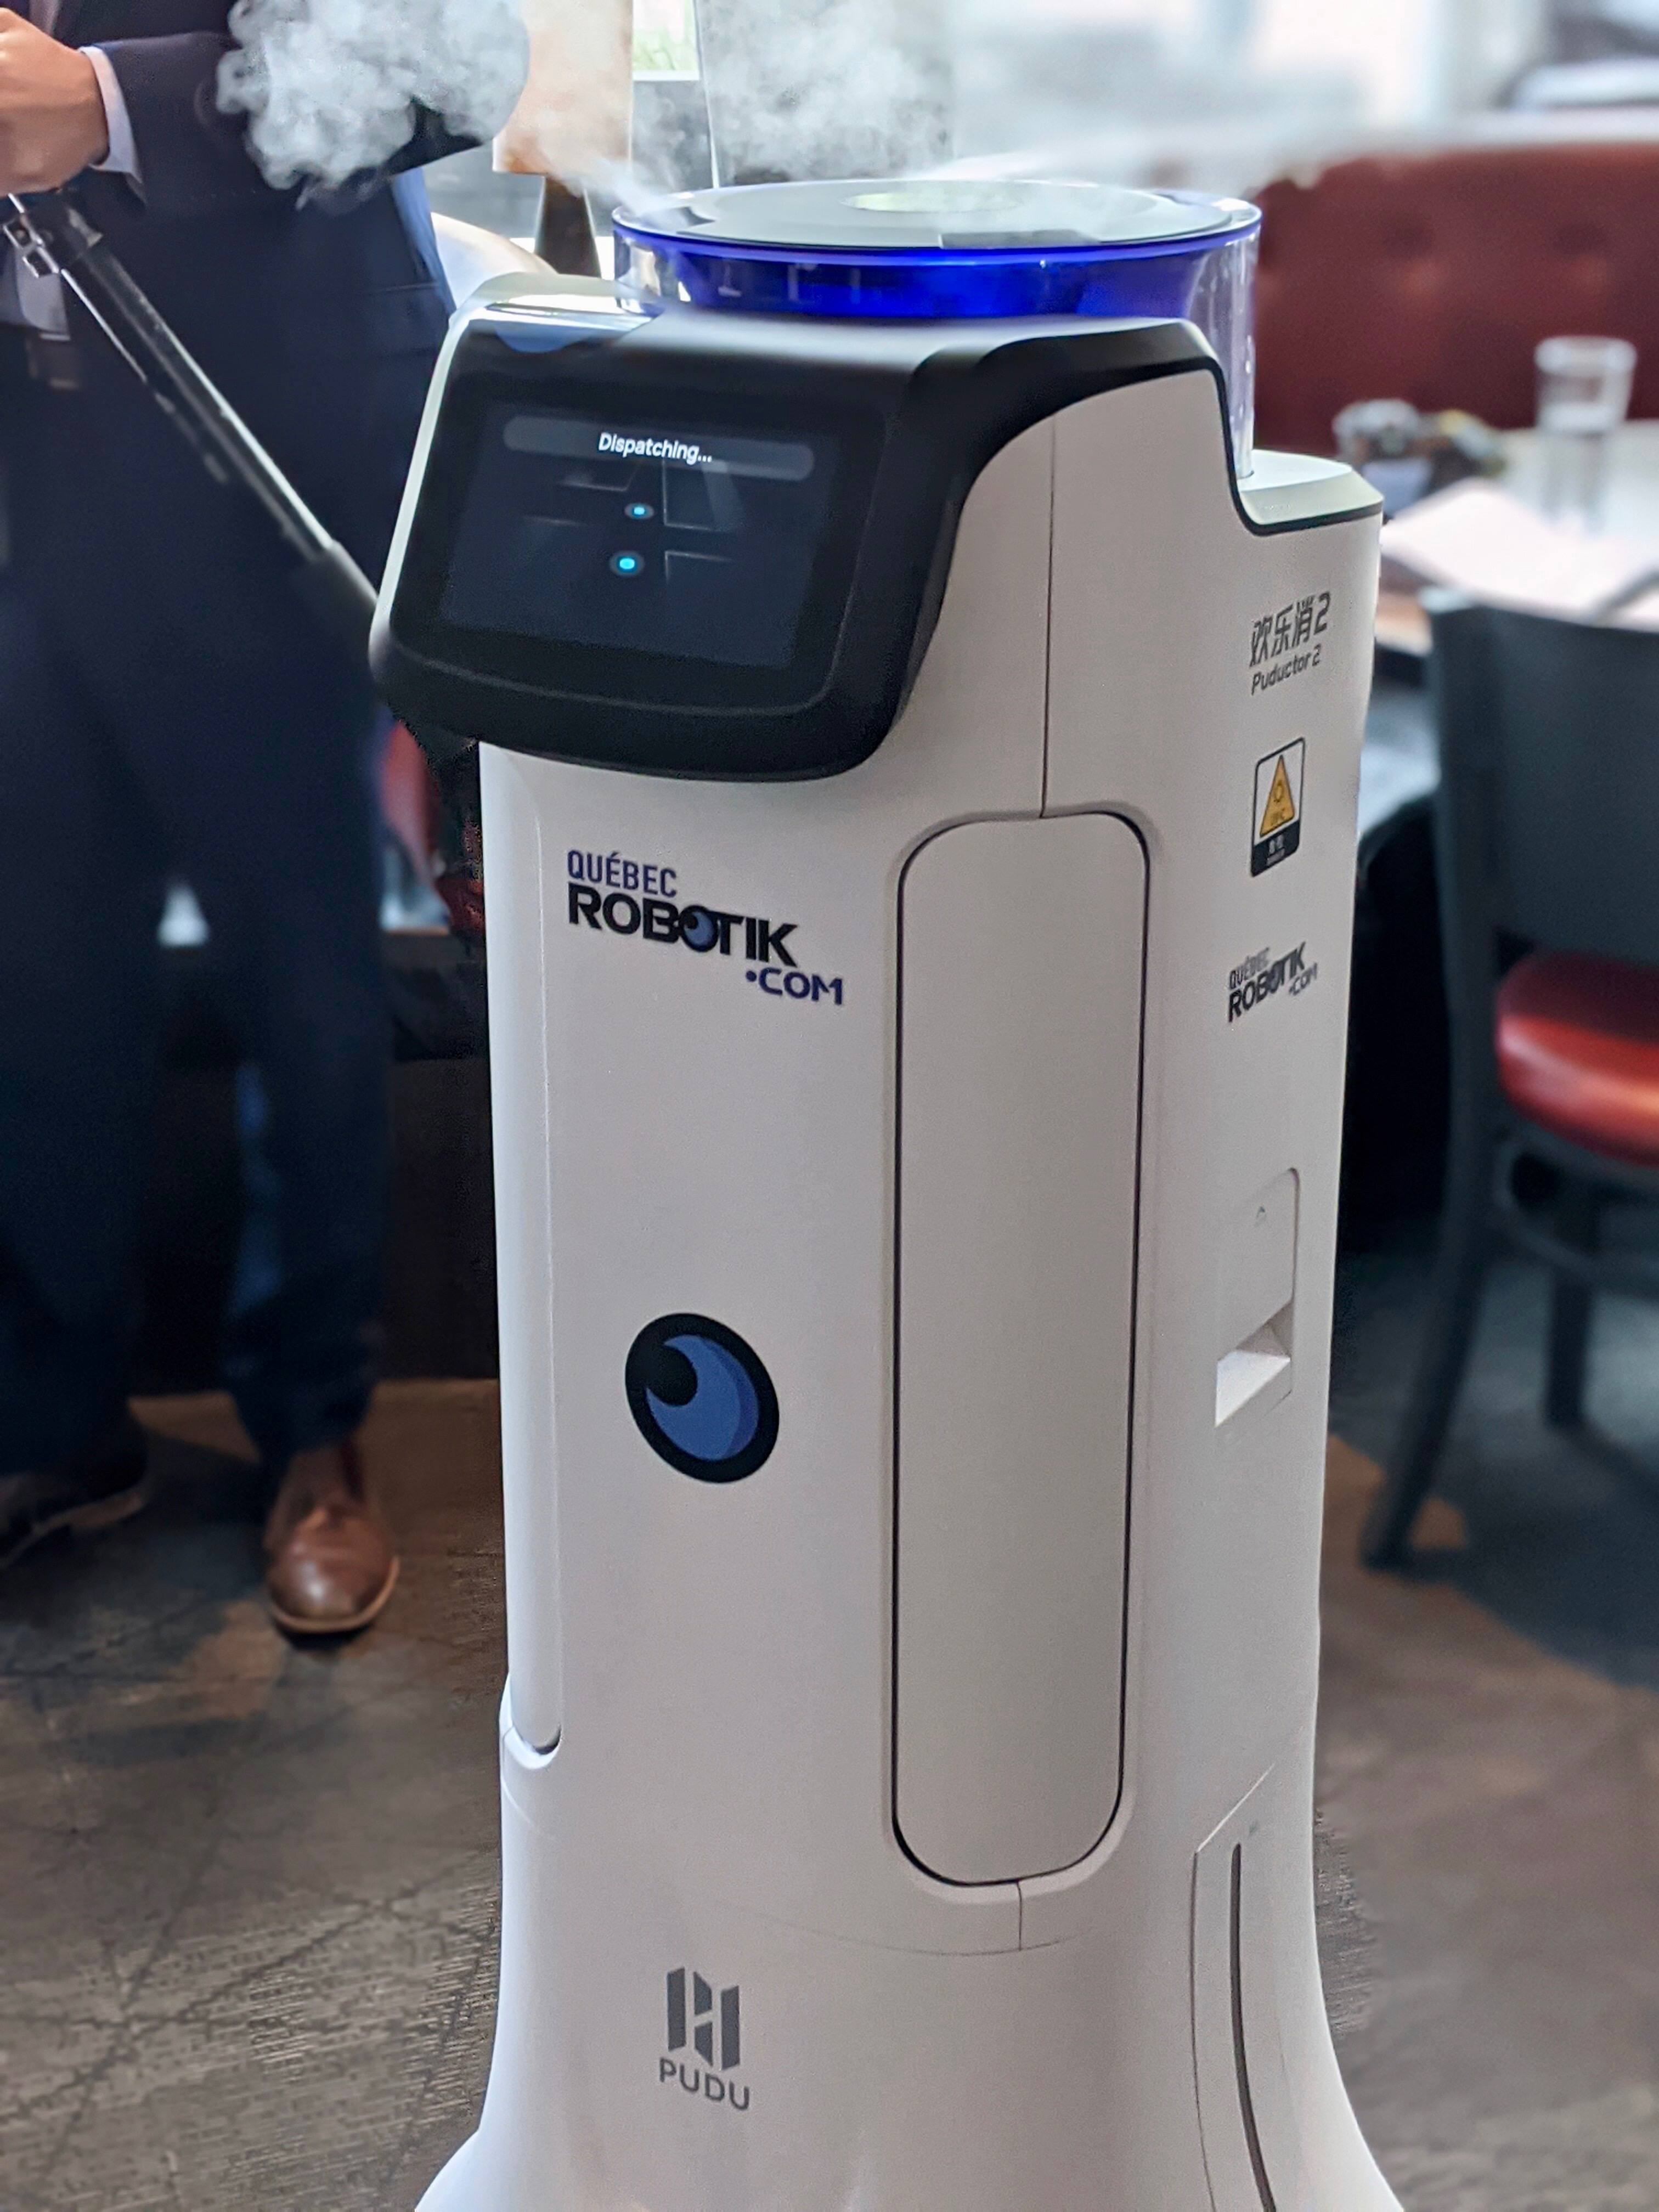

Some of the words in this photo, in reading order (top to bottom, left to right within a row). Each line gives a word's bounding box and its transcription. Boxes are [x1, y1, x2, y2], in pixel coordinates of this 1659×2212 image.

[598, 432, 713, 465] Dispatching...
[1251, 652, 1311, 696] Puductor
[1312, 644, 1322, 667] 2
[567, 849, 678, 898] QUÉBEC
[568, 882, 798, 968] ROBOTIK
[1228, 941, 1306, 1023] ROBOTIK
[659, 2057, 749, 2111] PUDU
